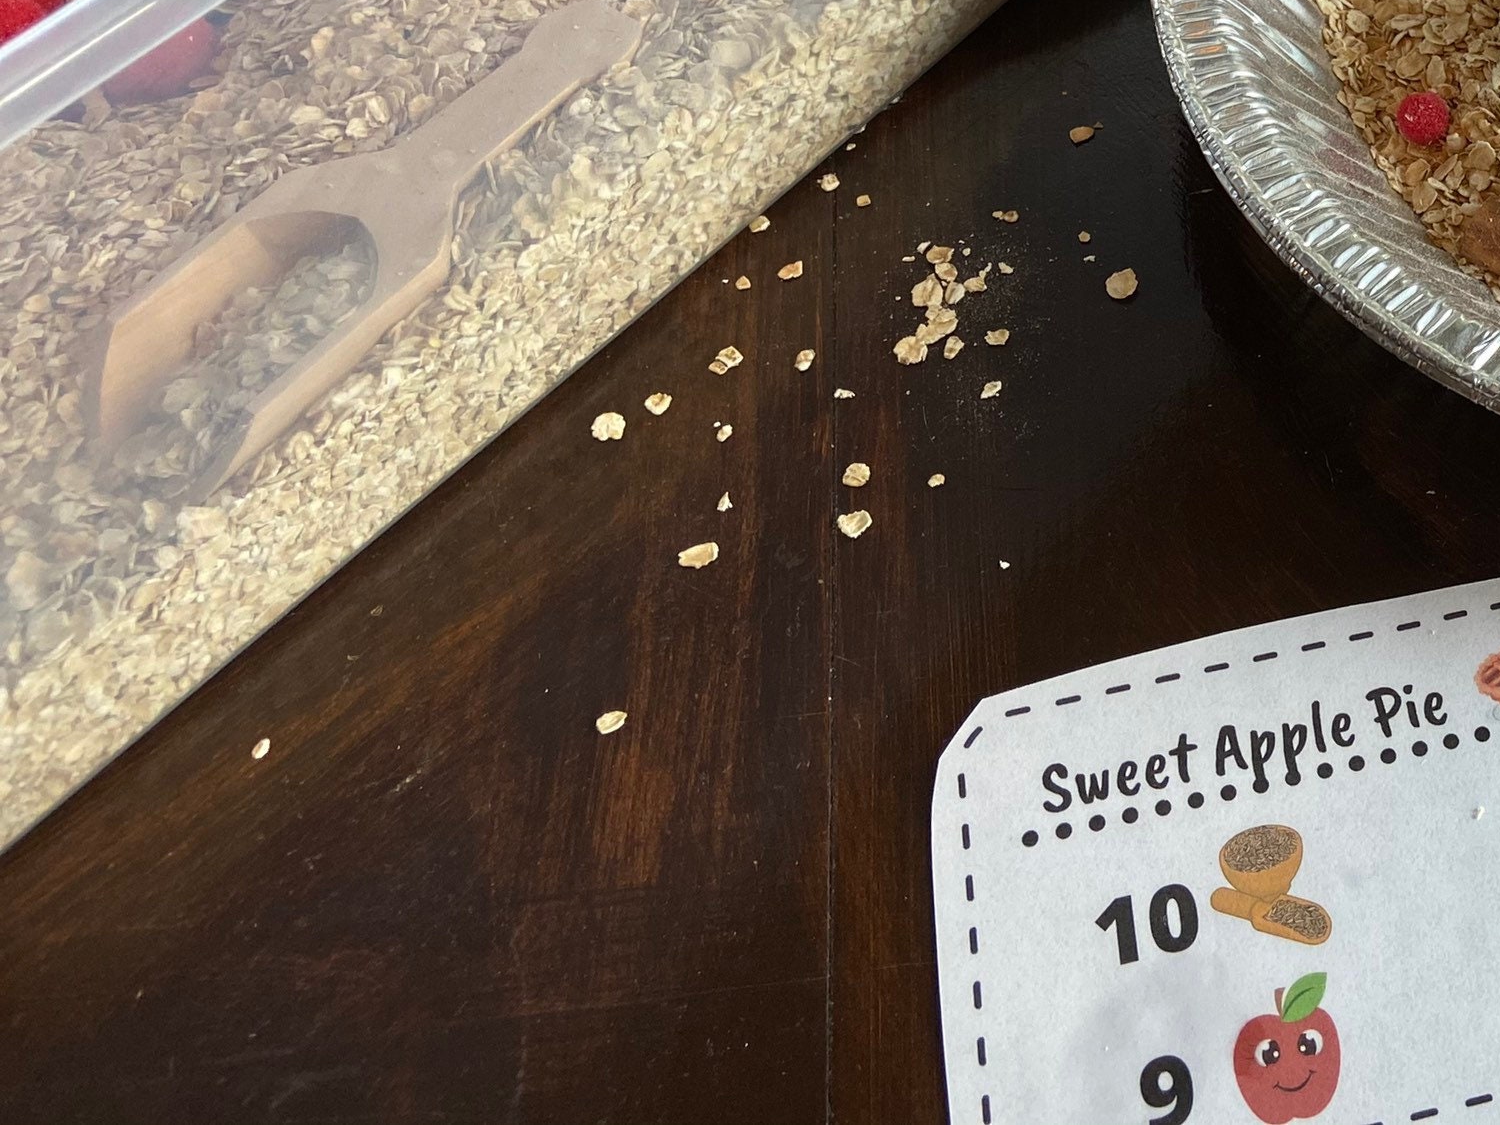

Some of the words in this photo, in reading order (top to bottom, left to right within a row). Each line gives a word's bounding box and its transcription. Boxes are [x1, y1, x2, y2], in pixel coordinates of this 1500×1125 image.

[1041, 732, 1199, 814] Sweet
[1215, 699, 1356, 794] Apple
[1365, 683, 1448, 738] Pie
[1094, 883, 1199, 966] 10
[1139, 1055, 1194, 1125] 9
